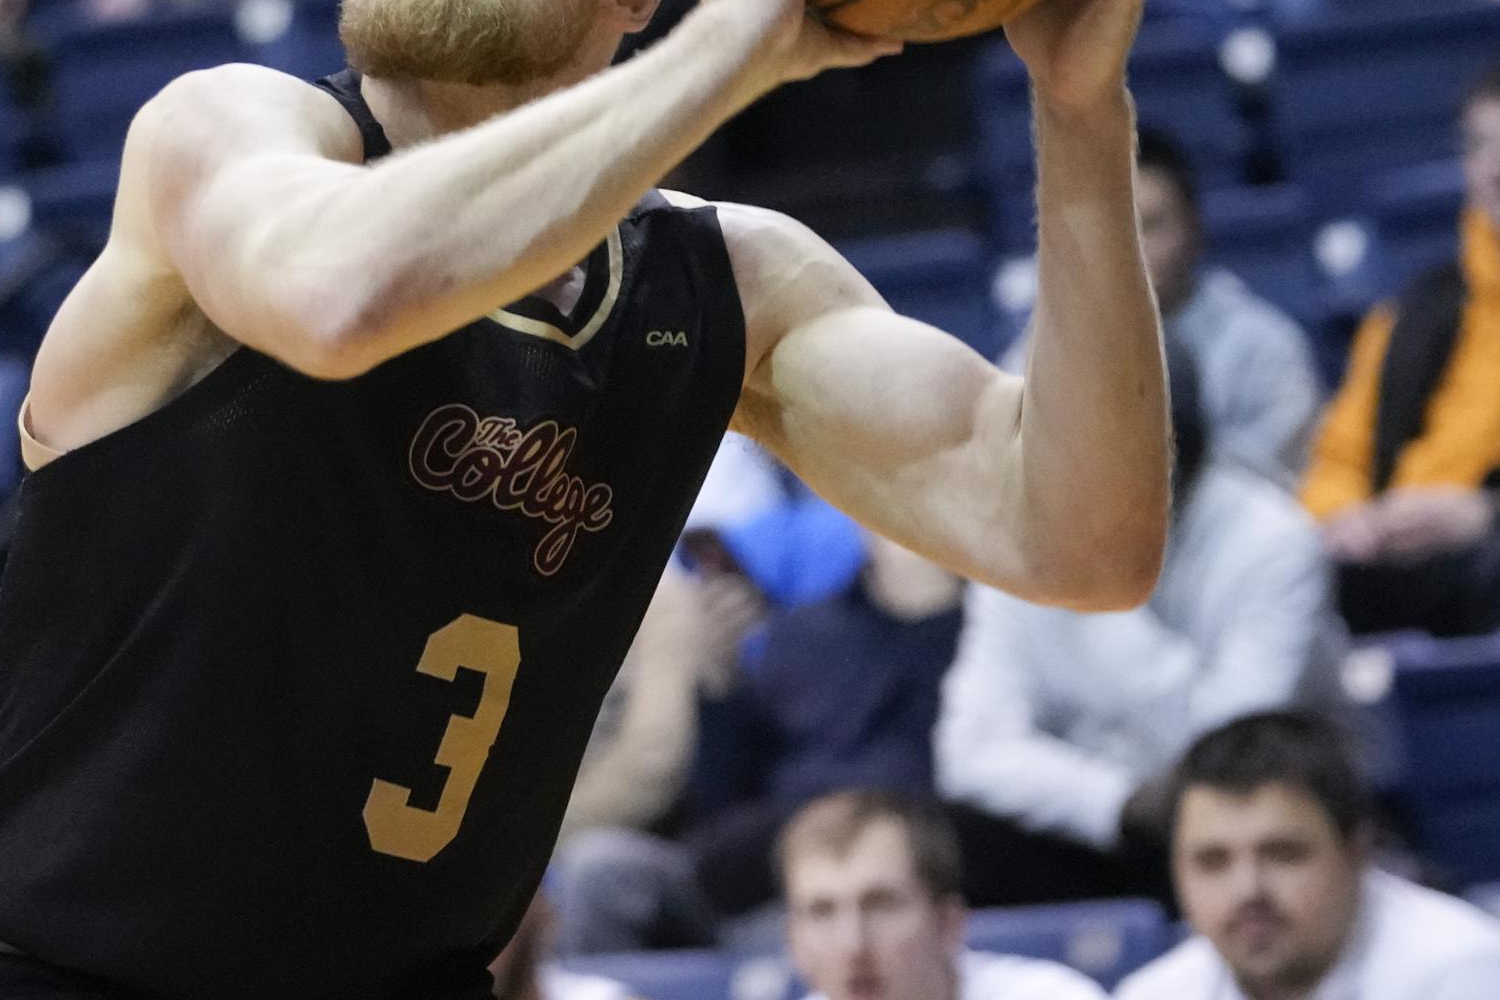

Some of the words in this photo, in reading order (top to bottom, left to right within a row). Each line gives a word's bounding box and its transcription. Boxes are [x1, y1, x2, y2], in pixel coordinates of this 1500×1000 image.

[646, 330, 688, 347] CAA
[476, 416, 522, 449] The
[409, 403, 613, 576] College
[363, 613, 521, 862] 3
